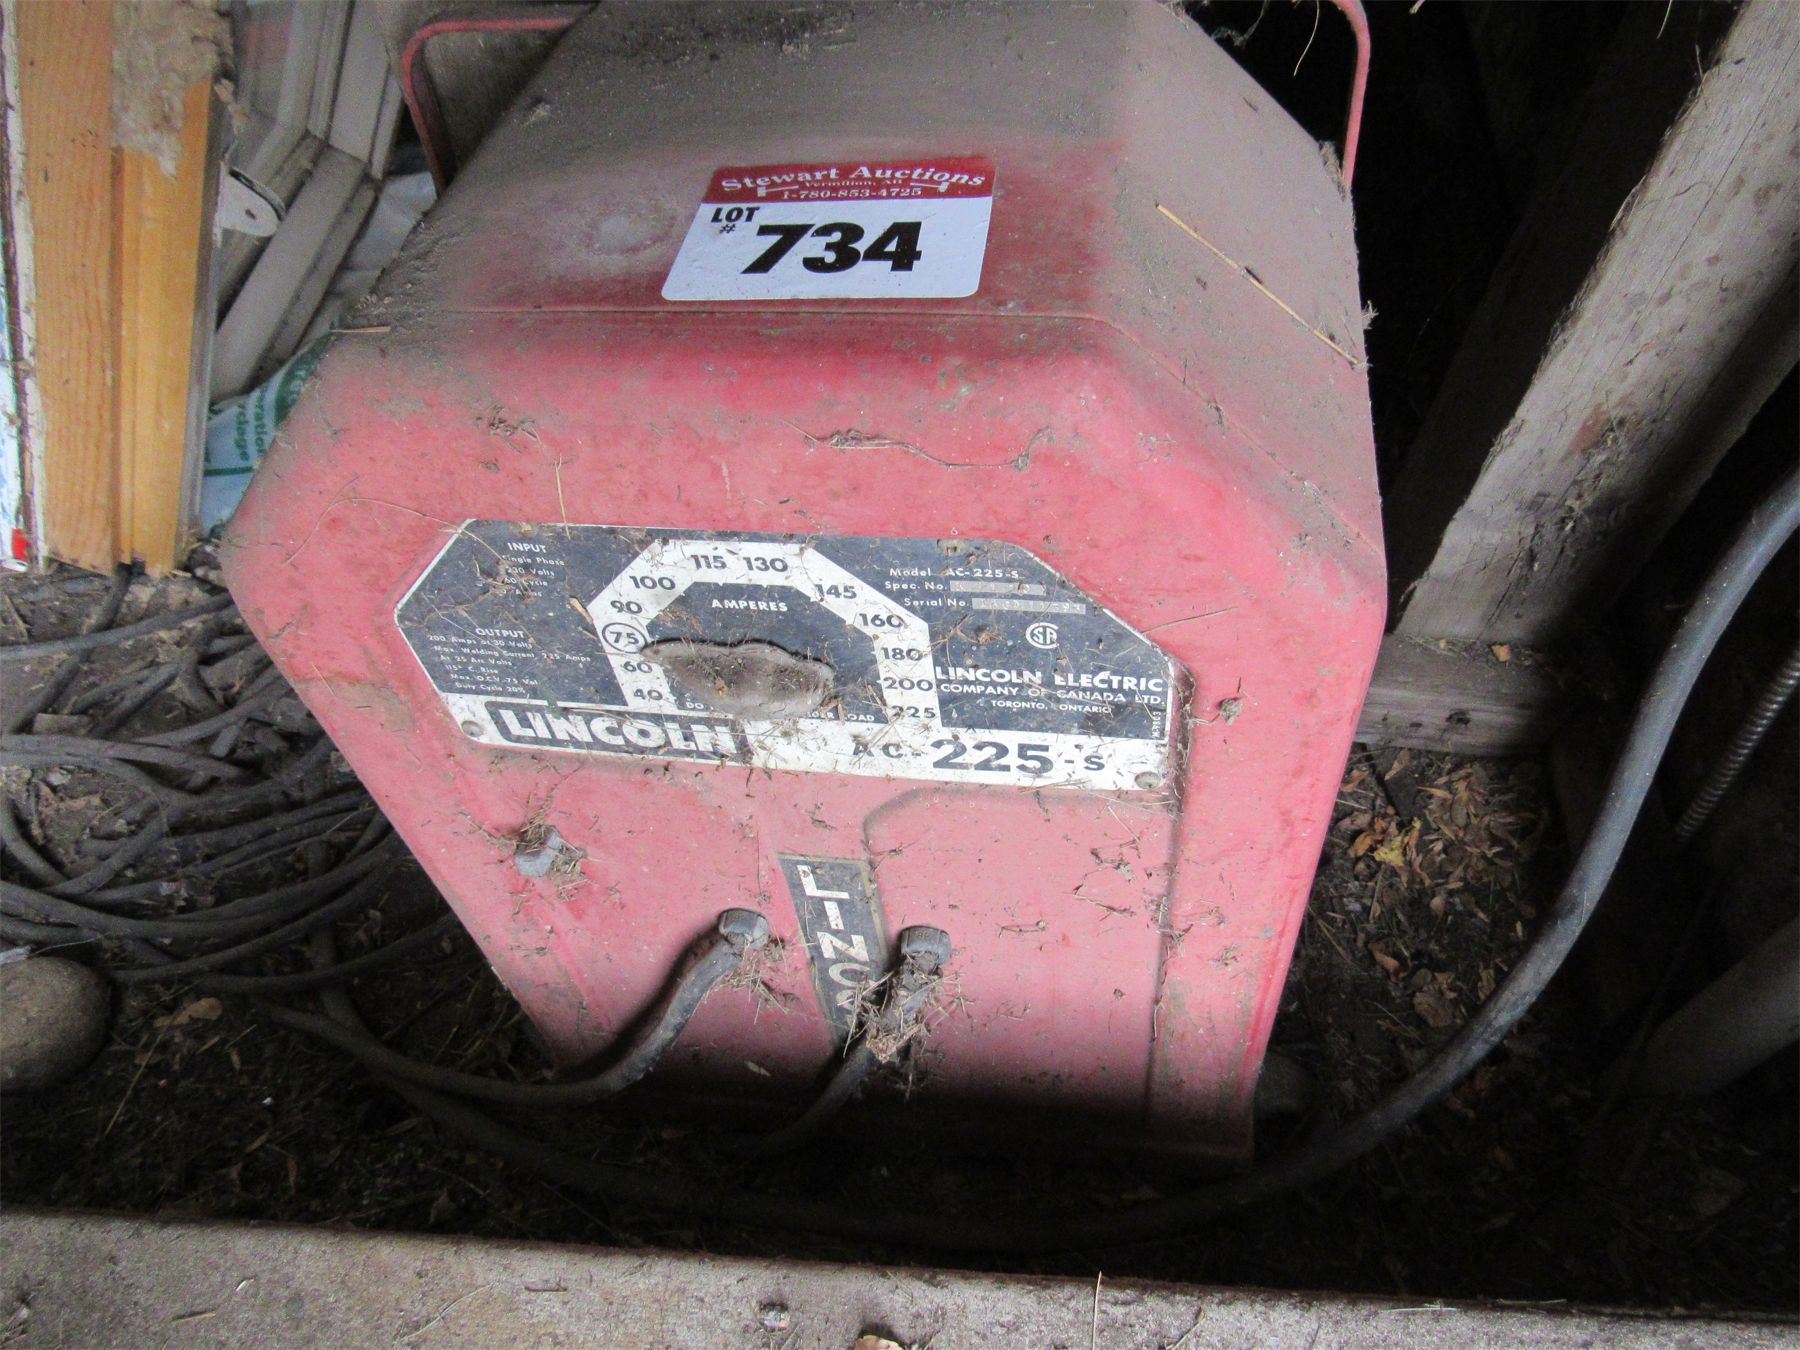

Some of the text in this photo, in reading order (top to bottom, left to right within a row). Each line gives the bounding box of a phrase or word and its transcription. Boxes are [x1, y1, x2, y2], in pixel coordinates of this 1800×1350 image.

[721, 165, 986, 191] Stewart Auctions
[783, 187, 922, 200] 1-780-853-4725
[710, 206, 760, 223] LOT
[719, 224, 736, 234] #
[741, 221, 922, 275] 734
[507, 542, 546, 553] INPUT
[536, 557, 565, 566] Phase
[690, 553, 789, 573] 115 130
[529, 567, 555, 577] Volts
[889, 568, 932, 577] Model
[629, 575, 676, 591] 100
[885, 581, 921, 591] Spec.
[925, 581, 947, 590] No.
[815, 584, 858, 599] 145
[610, 600, 642, 615] 90
[711, 599, 788, 612] AMPERES
[904, 598, 942, 607] Serial
[947, 598, 969, 608] No.
[858, 612, 904, 628] 160
[476, 627, 524, 638] OUTPUT
[610, 631, 640, 645] 75
[508, 641, 533, 649] Volts
[461, 647, 500, 657] Welding
[503, 650, 535, 658] Current
[565, 654, 592, 662] Amps
[881, 646, 925, 661] 180
[623, 660, 653, 674] 60
[883, 677, 934, 692] 200
[935, 667, 1164, 692] LINCOLN ELECTRIC
[632, 688, 663, 701] 40
[940, 683, 1165, 705] COMPANY OF CANADA LTD.
[686, 701, 705, 710] DO
[892, 705, 936, 719] 225
[991, 699, 1112, 714] TORONTO, ONTARIO
[498, 708, 738, 755] LINCOLN
